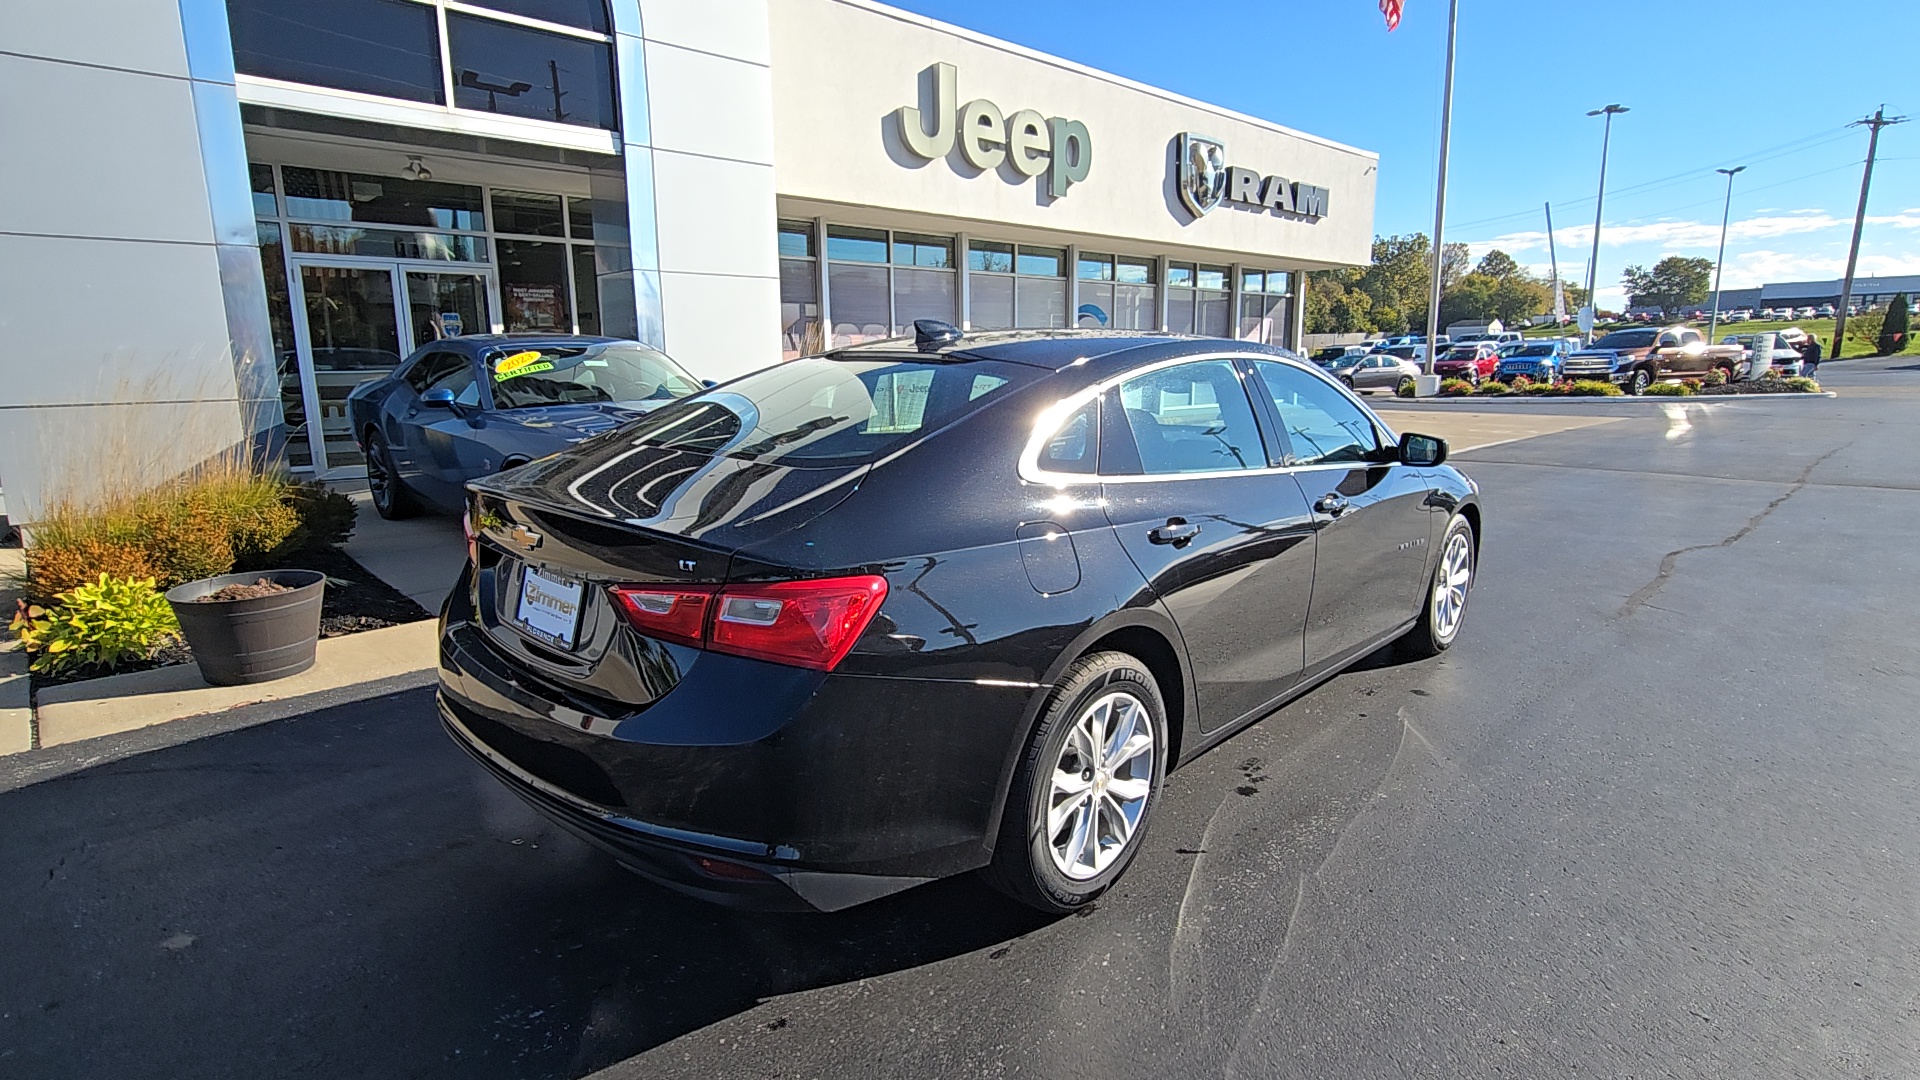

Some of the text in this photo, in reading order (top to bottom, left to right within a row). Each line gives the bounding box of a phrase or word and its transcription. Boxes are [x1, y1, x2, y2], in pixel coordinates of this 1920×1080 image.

[903, 62, 1092, 197] Jeep
[1226, 165, 1329, 218] RAM
[497, 363, 551, 380] CERTIFIED
[504, 353, 534, 370] 2023
[678, 559, 697, 572] LT
[527, 582, 577, 616] Zimmer
